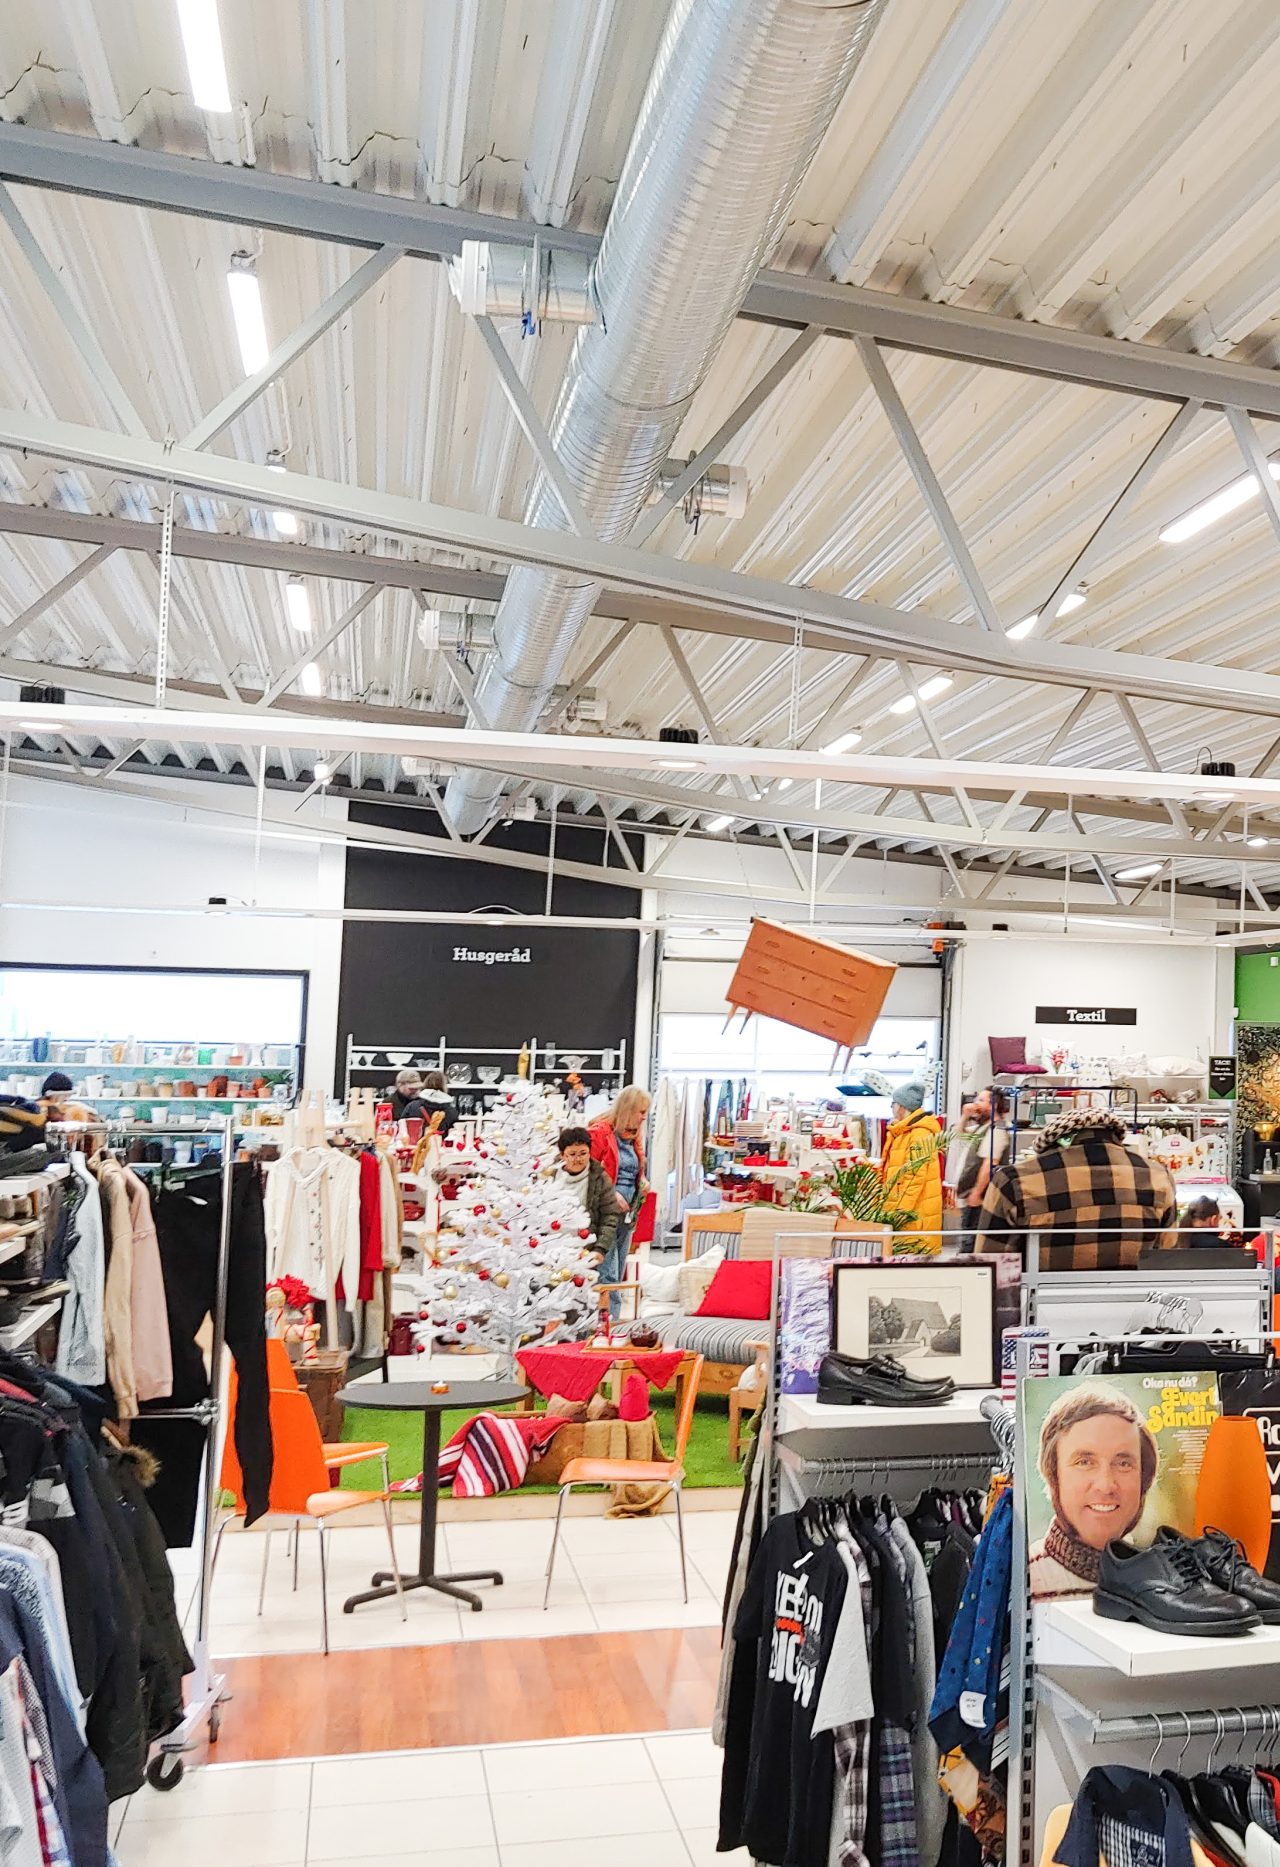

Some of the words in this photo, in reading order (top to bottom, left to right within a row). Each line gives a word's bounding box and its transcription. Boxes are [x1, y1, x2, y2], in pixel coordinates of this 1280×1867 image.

[452, 947, 531, 964] Husgeråd
[1066, 1009, 1106, 1022] Textil
[1165, 1379, 1177, 1388] nu
[1146, 1402, 1218, 1433] Sandin
